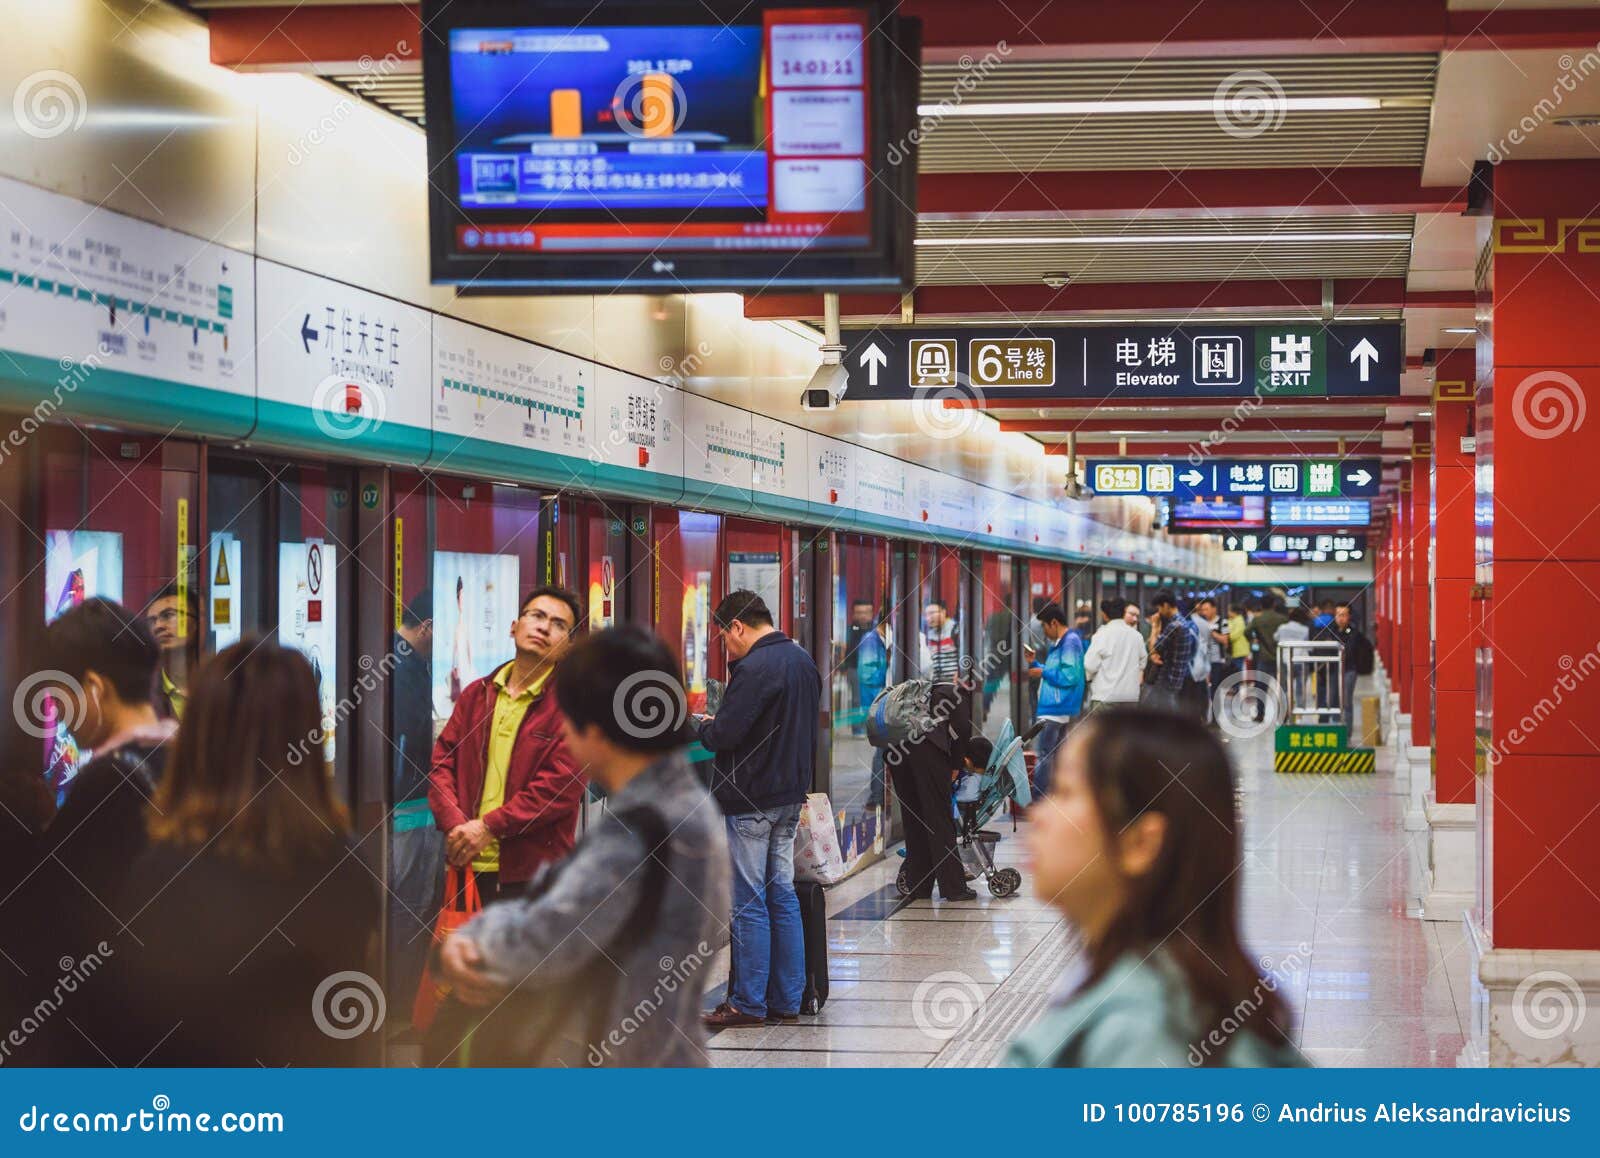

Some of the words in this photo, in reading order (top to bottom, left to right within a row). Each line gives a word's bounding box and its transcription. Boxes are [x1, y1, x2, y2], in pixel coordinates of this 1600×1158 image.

[1116, 337, 1176, 367] 电梯
[1007, 367, 1033, 379] Line
[1035, 368, 1044, 379] 6
[1116, 372, 1180, 386] Elevator
[1271, 372, 1311, 386] EXIT
[364, 490, 377, 503] 07
[633, 520, 645, 532] 08
